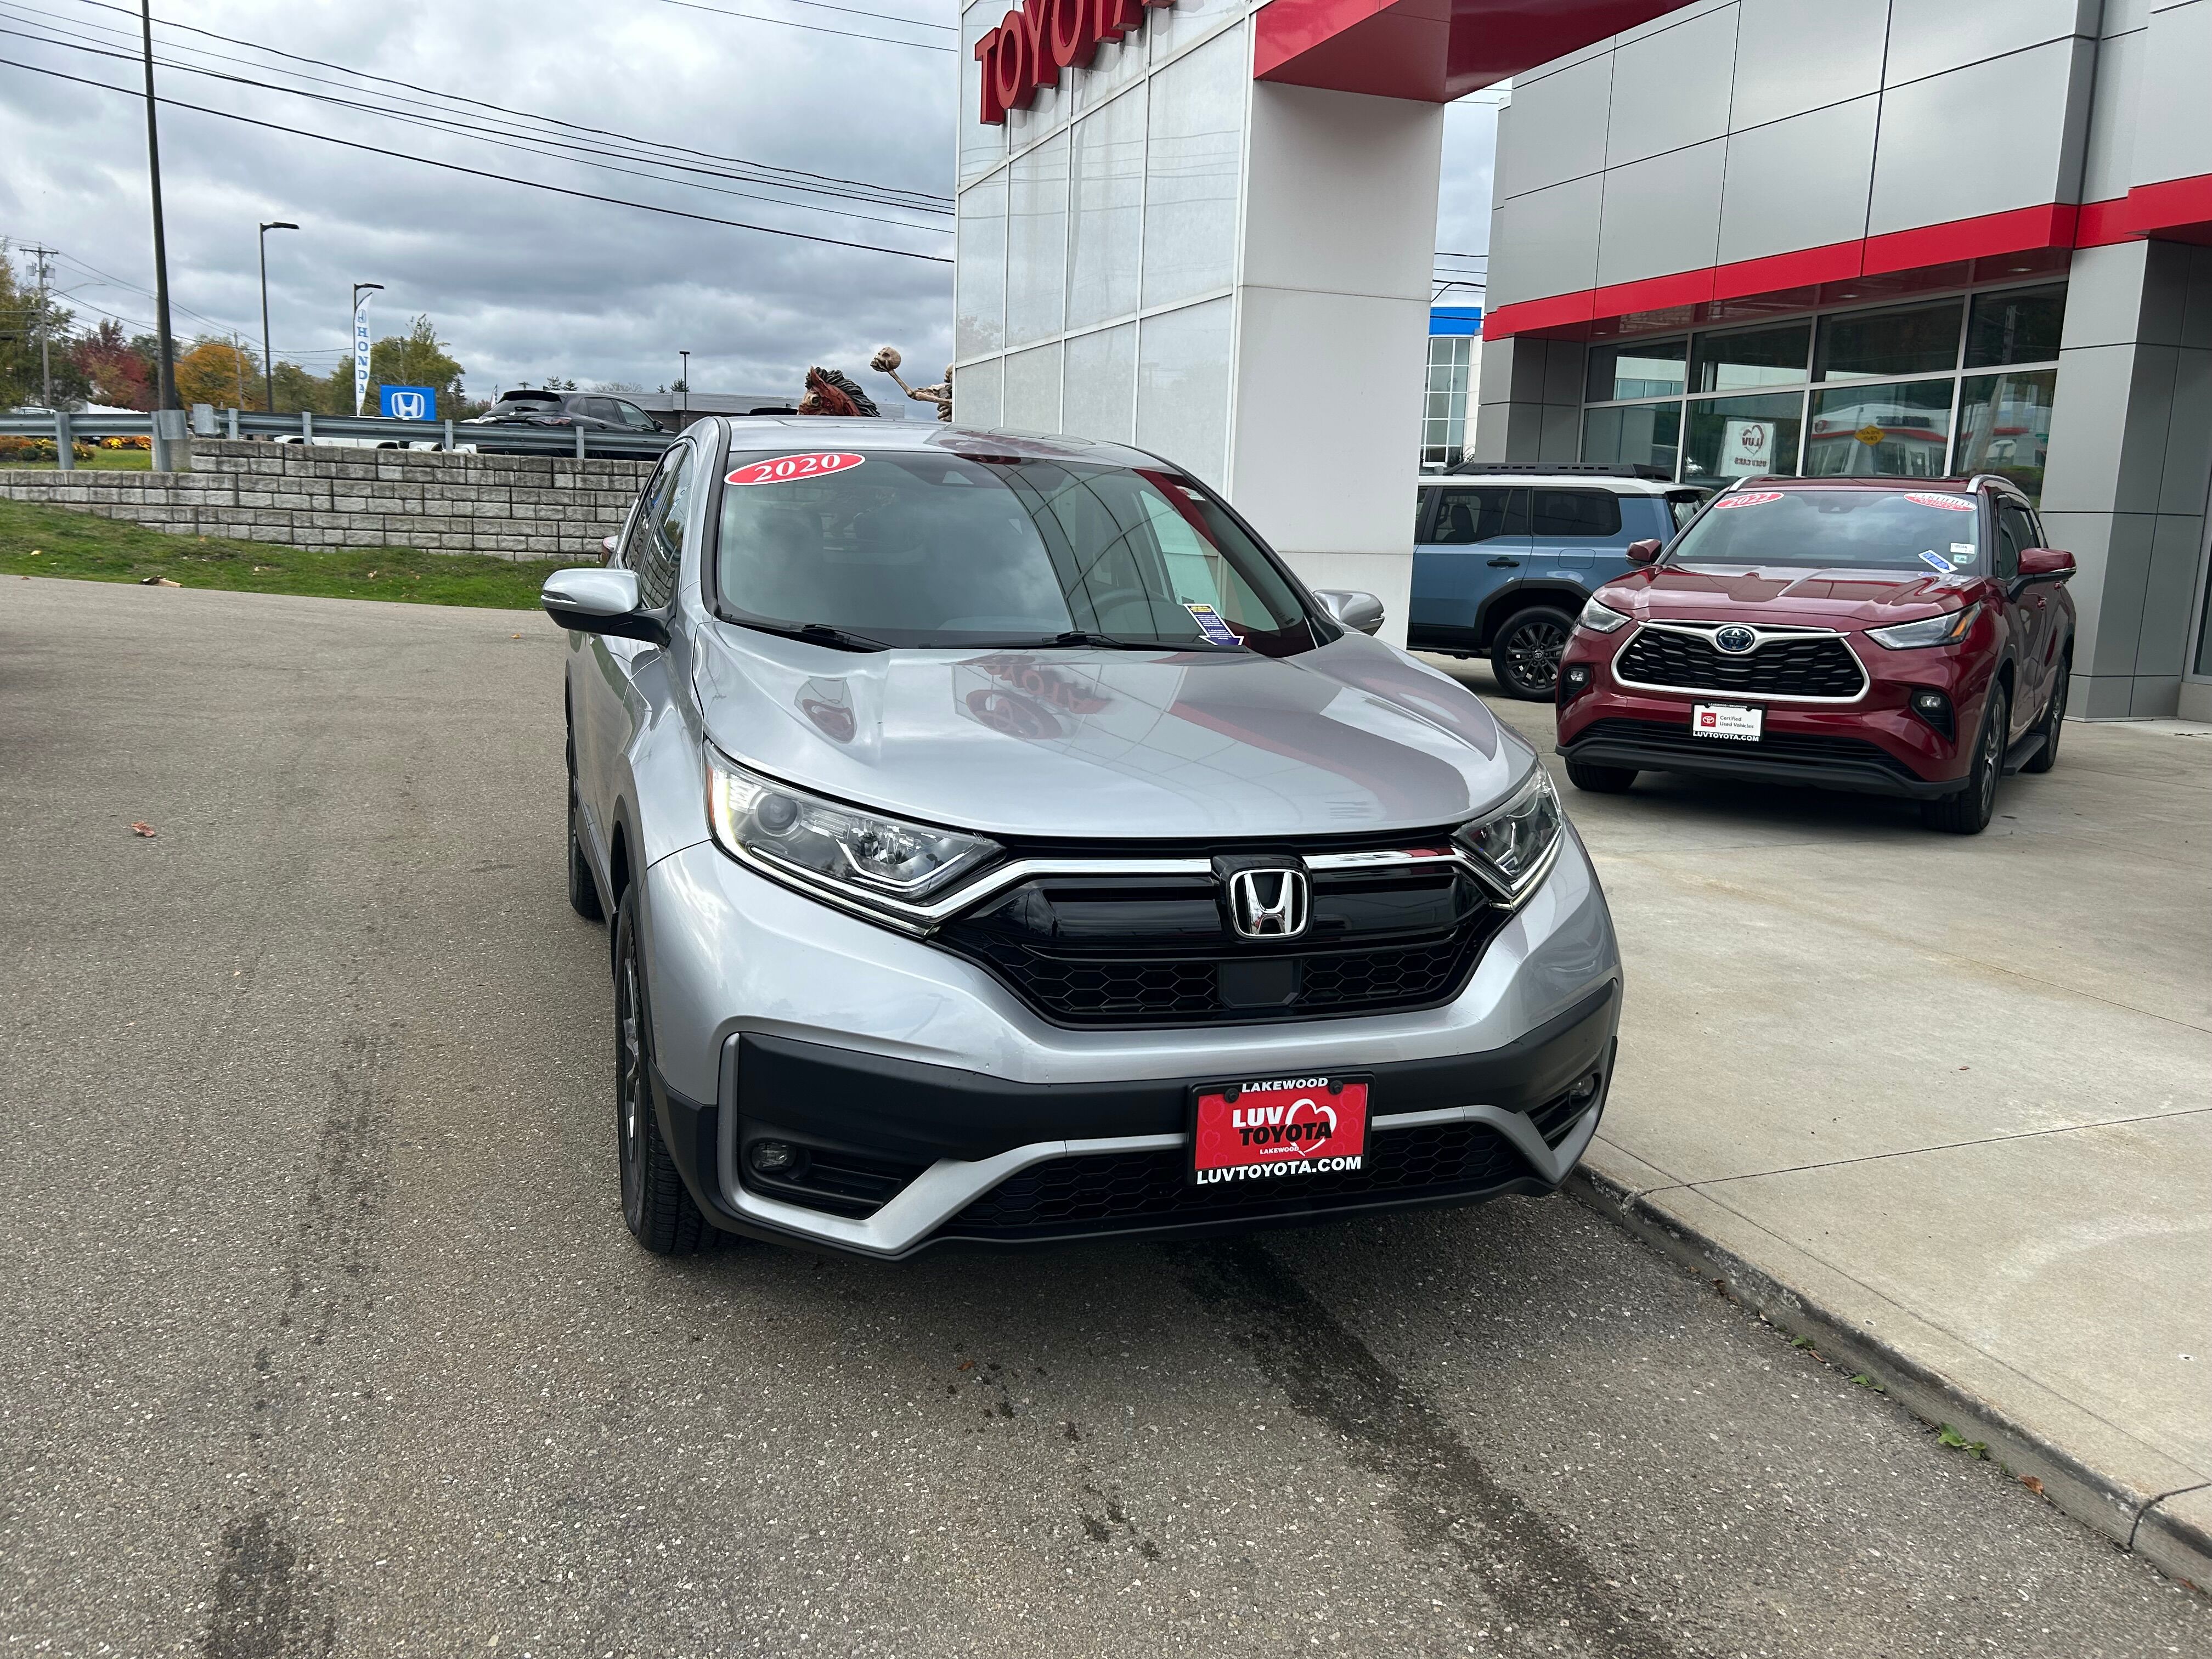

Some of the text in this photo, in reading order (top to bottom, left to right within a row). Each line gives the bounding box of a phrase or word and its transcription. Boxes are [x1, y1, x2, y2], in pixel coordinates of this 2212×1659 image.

[357, 326, 369, 393] HONDA
[753, 454, 841, 482] 2020
[1724, 493, 1773, 507] 2022
[1693, 731, 1759, 742] LUVTOYOTA.COM
[1242, 1078, 1328, 1093] LAKEWOOD
[1232, 1106, 1284, 1128] LUV
[1239, 1122, 1332, 1146] TOYOTA
[1260, 1146, 1299, 1155] LAKEWOOD
[1197, 1156, 1362, 1185] LUVTOYOTA.COM
